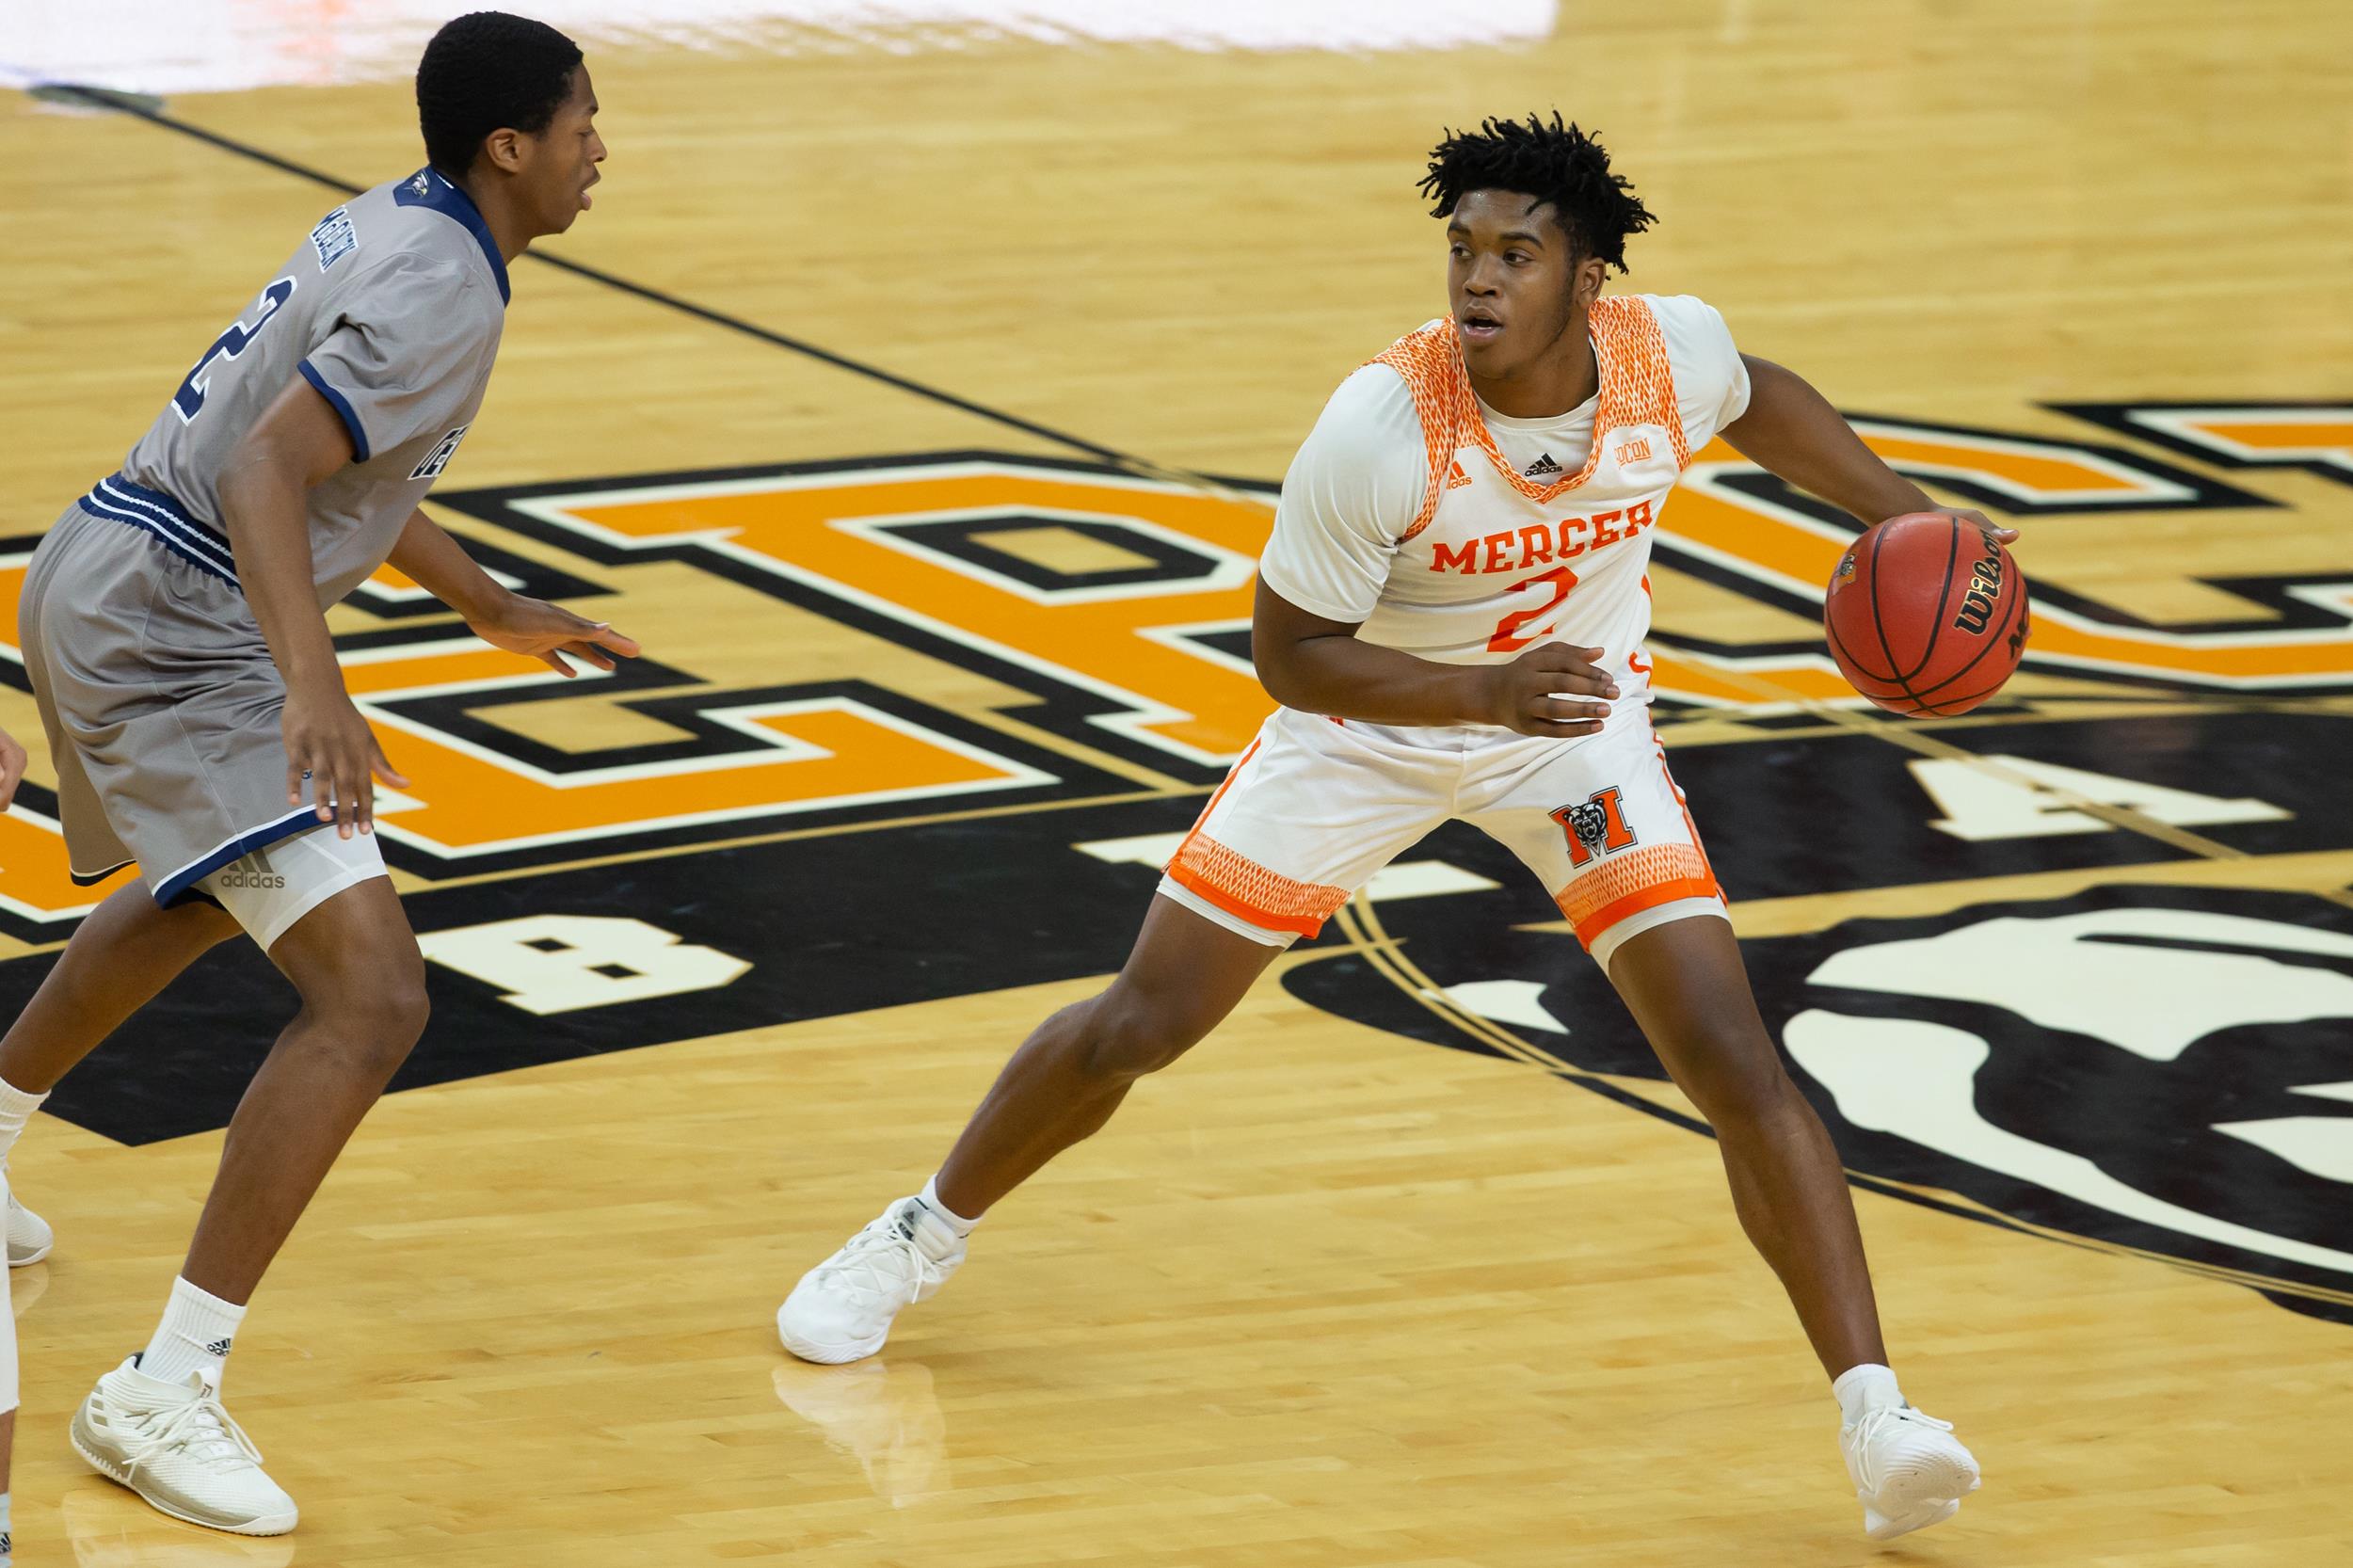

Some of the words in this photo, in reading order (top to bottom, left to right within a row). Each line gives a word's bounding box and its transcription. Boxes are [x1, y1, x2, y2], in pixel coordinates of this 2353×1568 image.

[171, 275, 297, 426] 2
[1524, 465, 1563, 477] adidas
[1429, 499, 1654, 575] MERCER
[1486, 565, 1579, 652] 2
[220, 872, 285, 889] adidas
